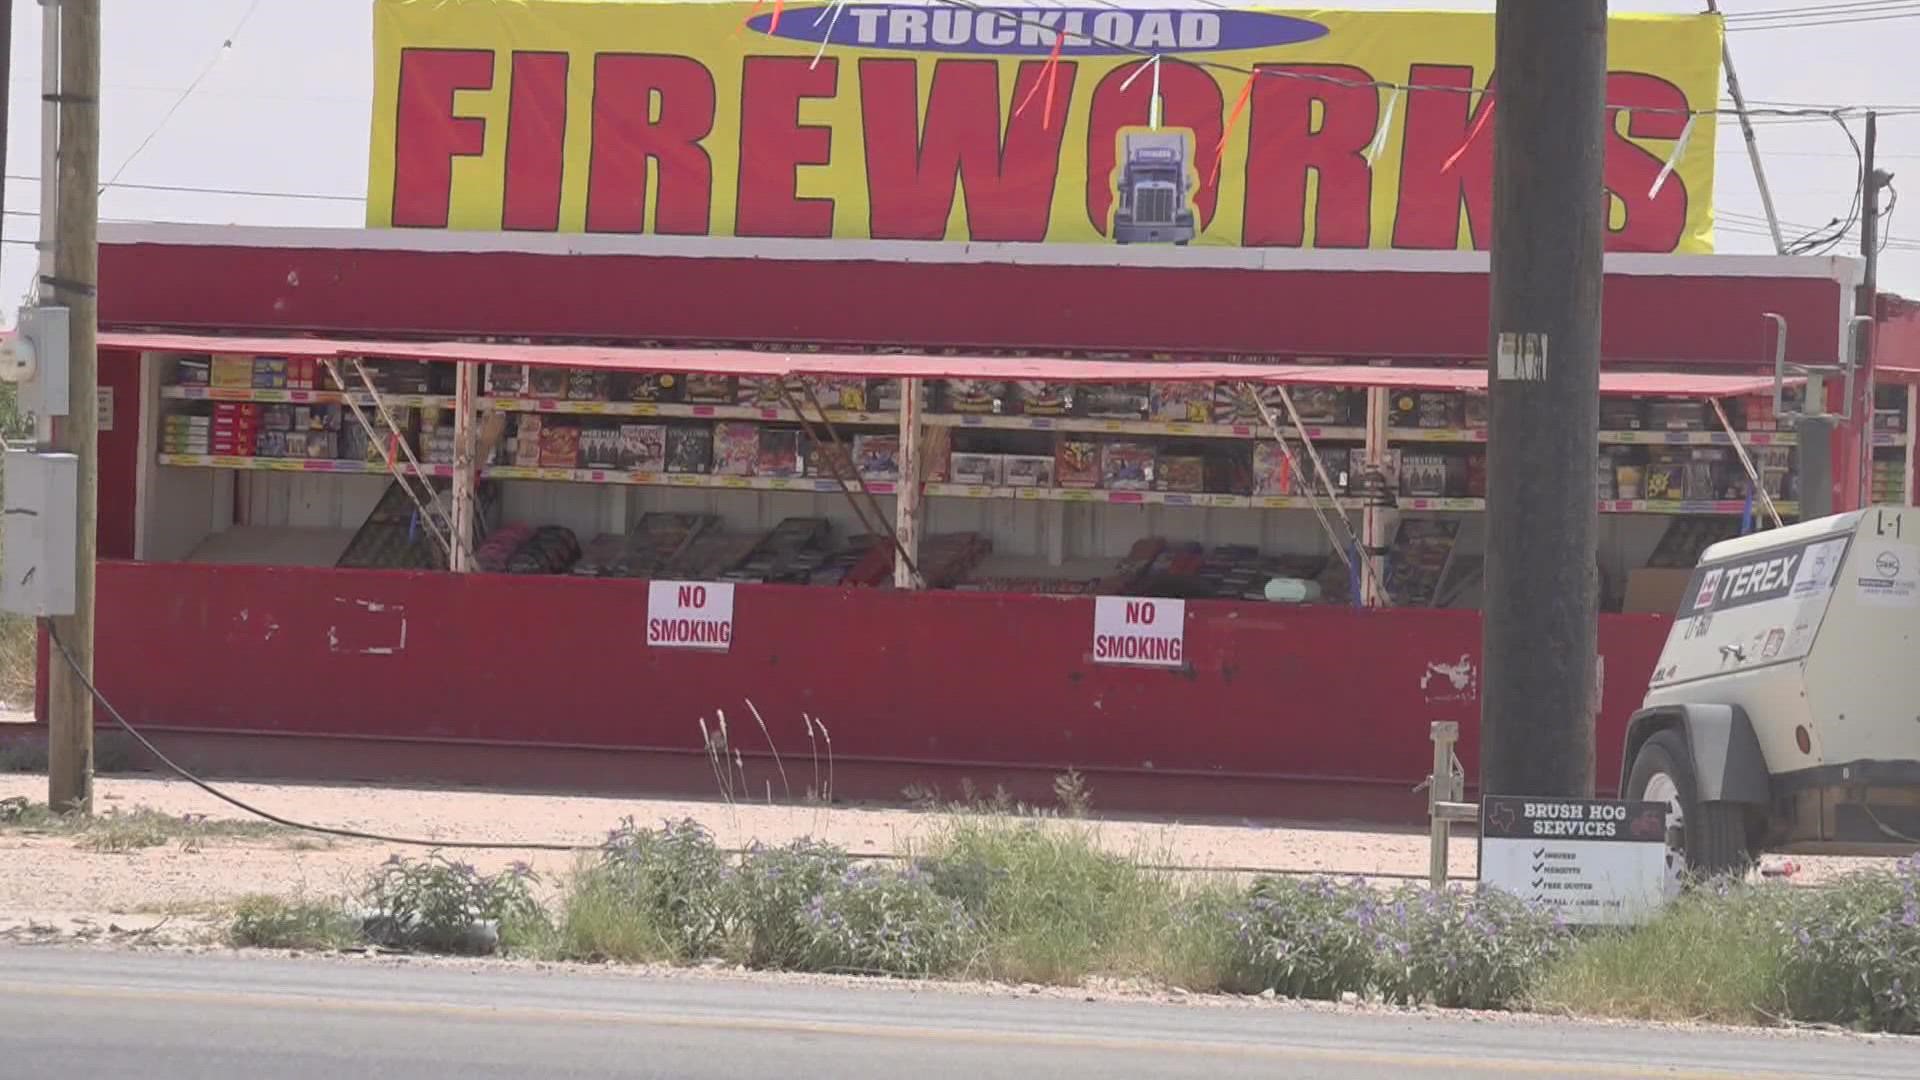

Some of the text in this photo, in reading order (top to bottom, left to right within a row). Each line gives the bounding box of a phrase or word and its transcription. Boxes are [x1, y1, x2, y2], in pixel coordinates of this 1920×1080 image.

[849, 9, 1221, 48] TRUCKLOAD
[391, 48, 1688, 253] FIREWORKS
[1877, 509, 1902, 540] L-1
[1722, 554, 1799, 600] TEREX
[679, 585, 706, 608] NO
[1126, 602, 1156, 625] NO
[649, 618, 730, 643] SMOKING
[1096, 635, 1181, 661] SMOKING
[1524, 803, 1626, 820] BRUSH HOG
[1533, 821, 1617, 837] SERVICES
